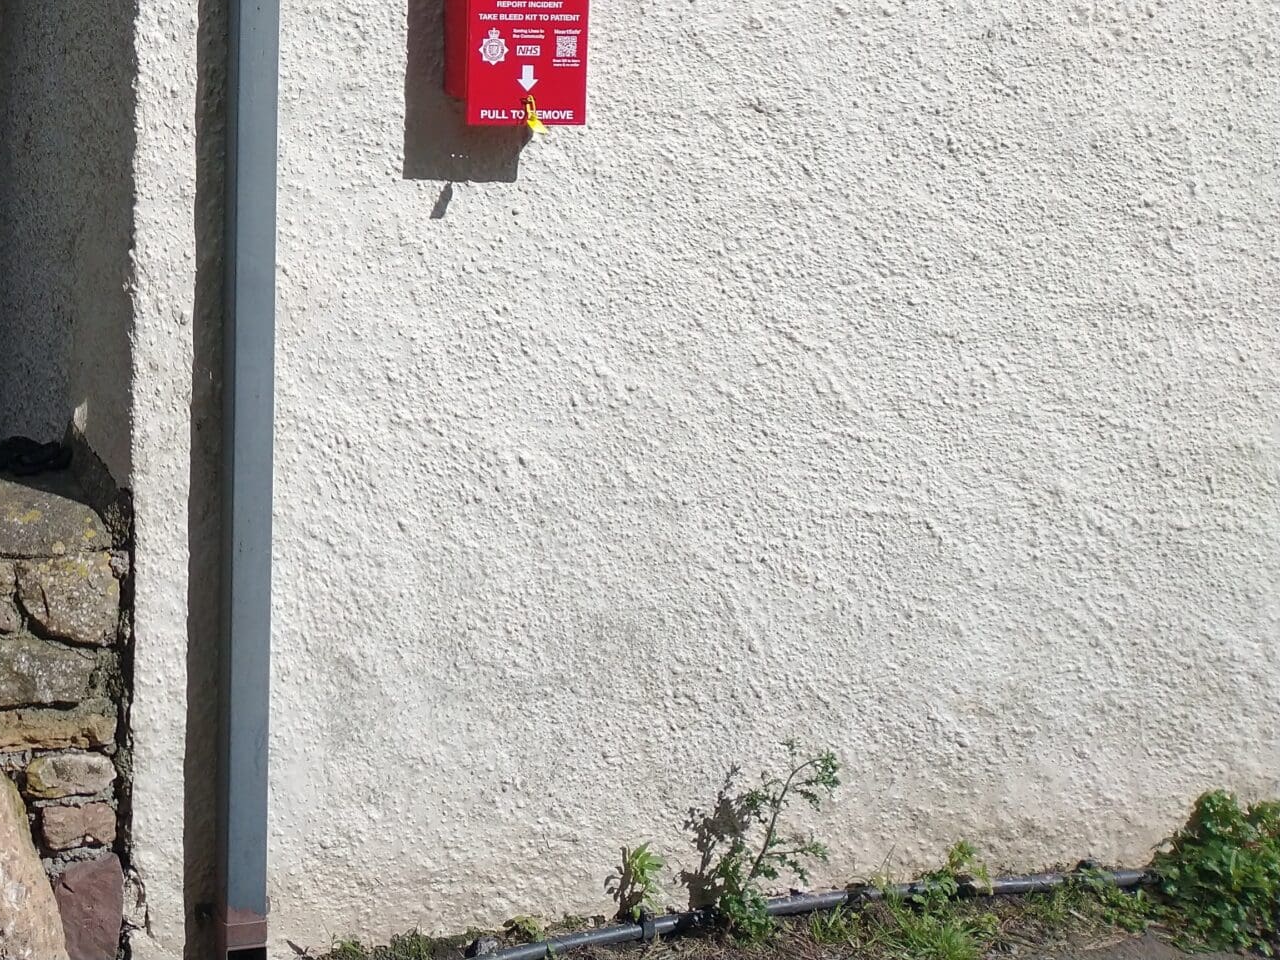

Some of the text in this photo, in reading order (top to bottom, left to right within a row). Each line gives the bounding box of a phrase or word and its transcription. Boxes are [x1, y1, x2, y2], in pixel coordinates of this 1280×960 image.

[496, 0, 563, 9] REPORT INCIDENT
[499, 13, 524, 21] BLEED
[517, 46, 539, 55] NHS
[480, 109, 508, 119] PULL
[510, 110, 525, 119] TO
